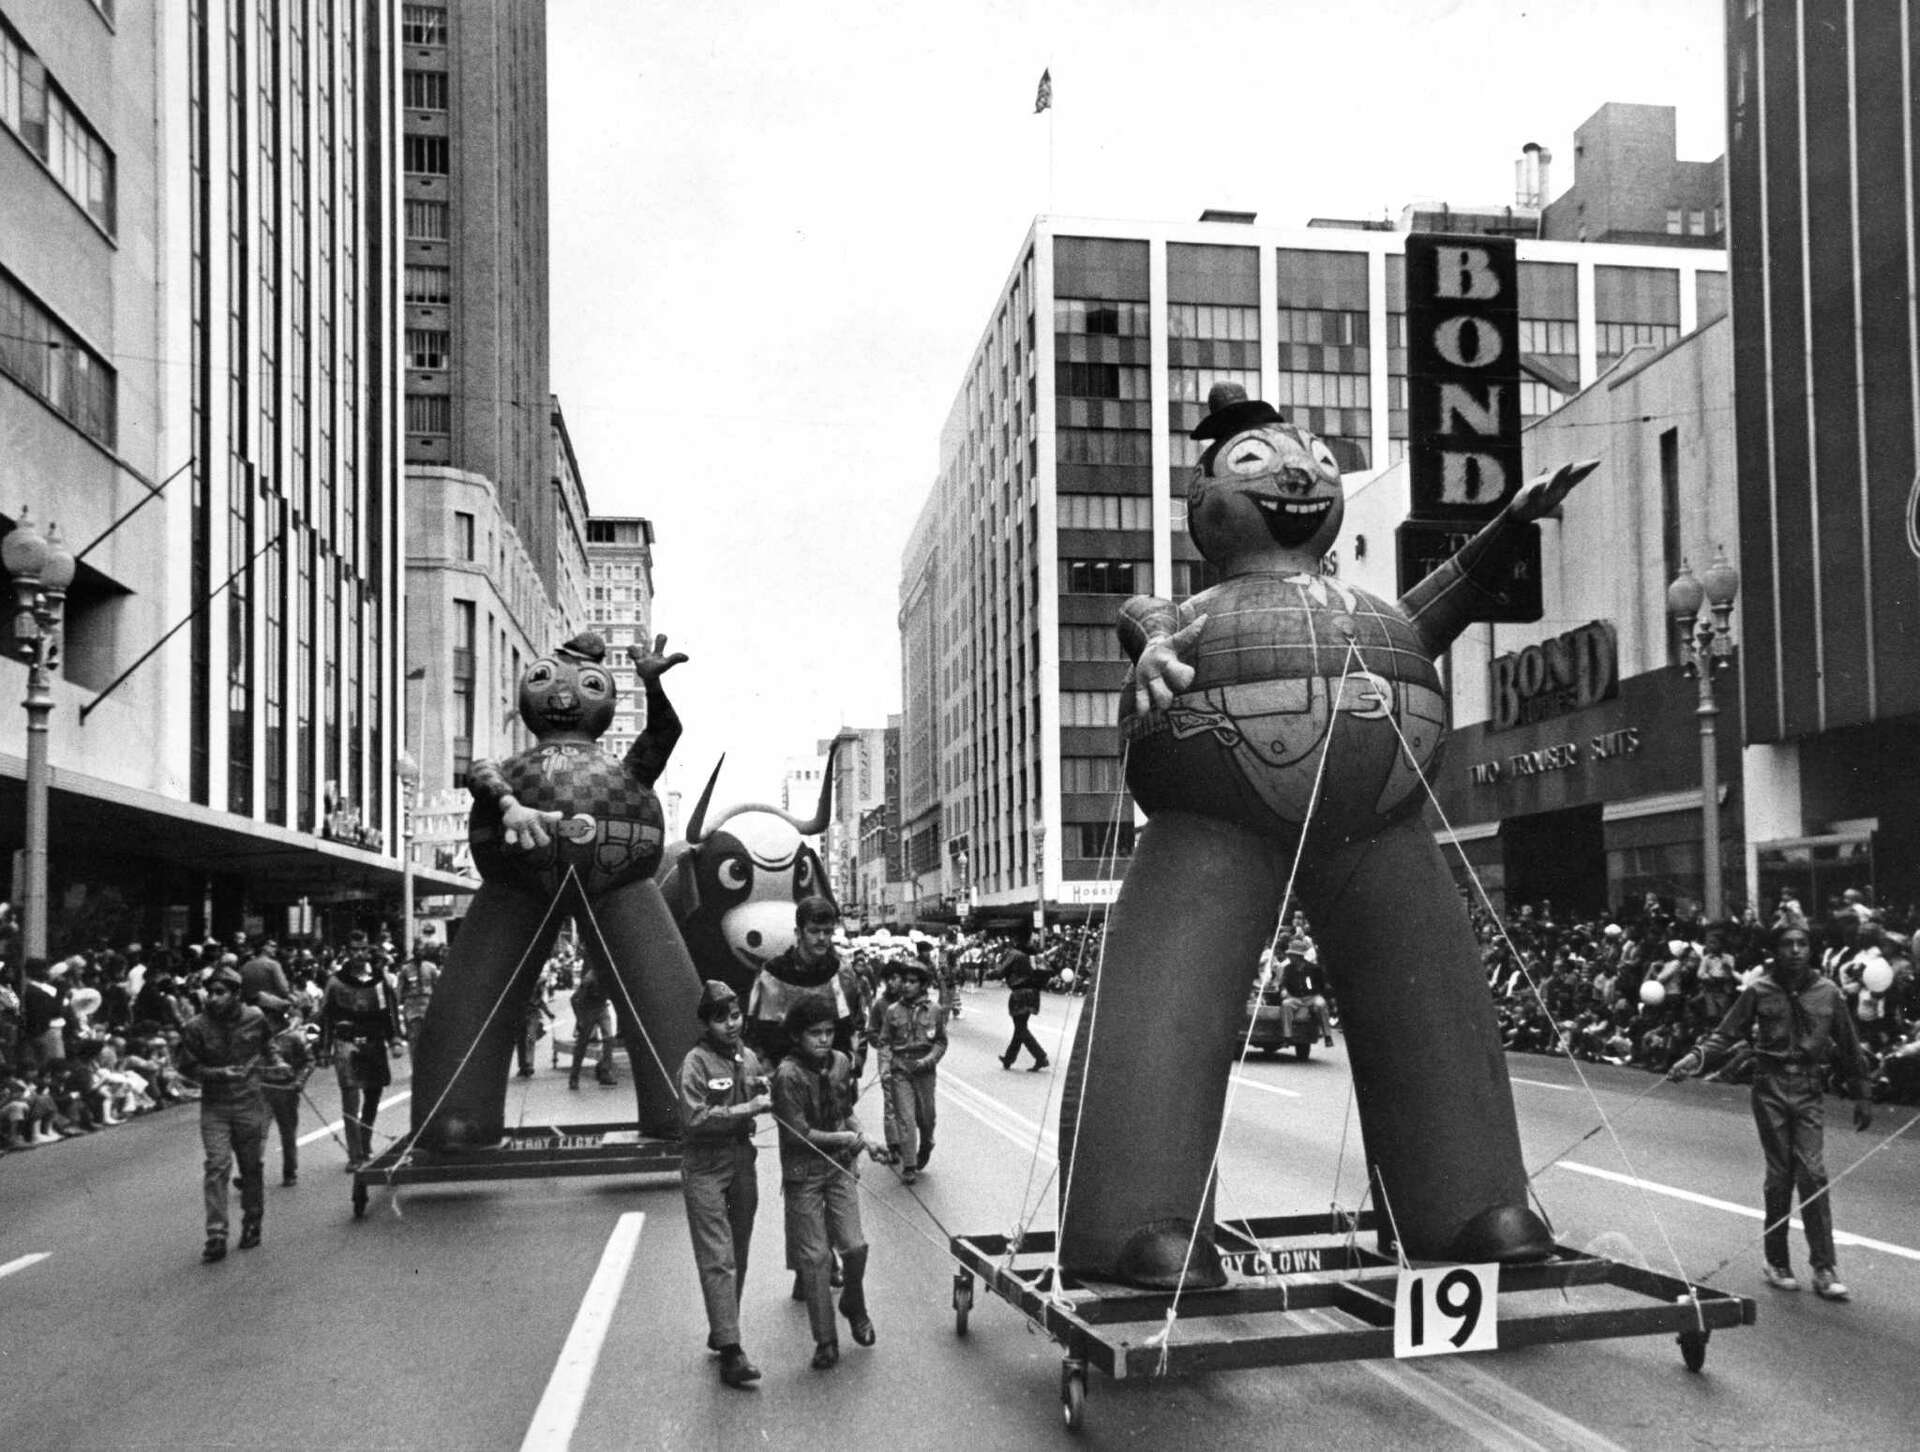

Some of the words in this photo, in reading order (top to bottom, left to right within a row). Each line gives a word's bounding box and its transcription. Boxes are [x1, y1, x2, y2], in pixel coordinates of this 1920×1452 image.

[1433, 245, 1507, 505] BOND
[1489, 618, 1617, 731] BOND
[1467, 760, 1500, 784] TWO
[1508, 743, 1576, 776] TROUSER
[1590, 726, 1640, 760] SUITS
[885, 735, 899, 873] KRESS
[1253, 1249, 1321, 1275] CLOWN
[1410, 1268, 1483, 1348] 19
